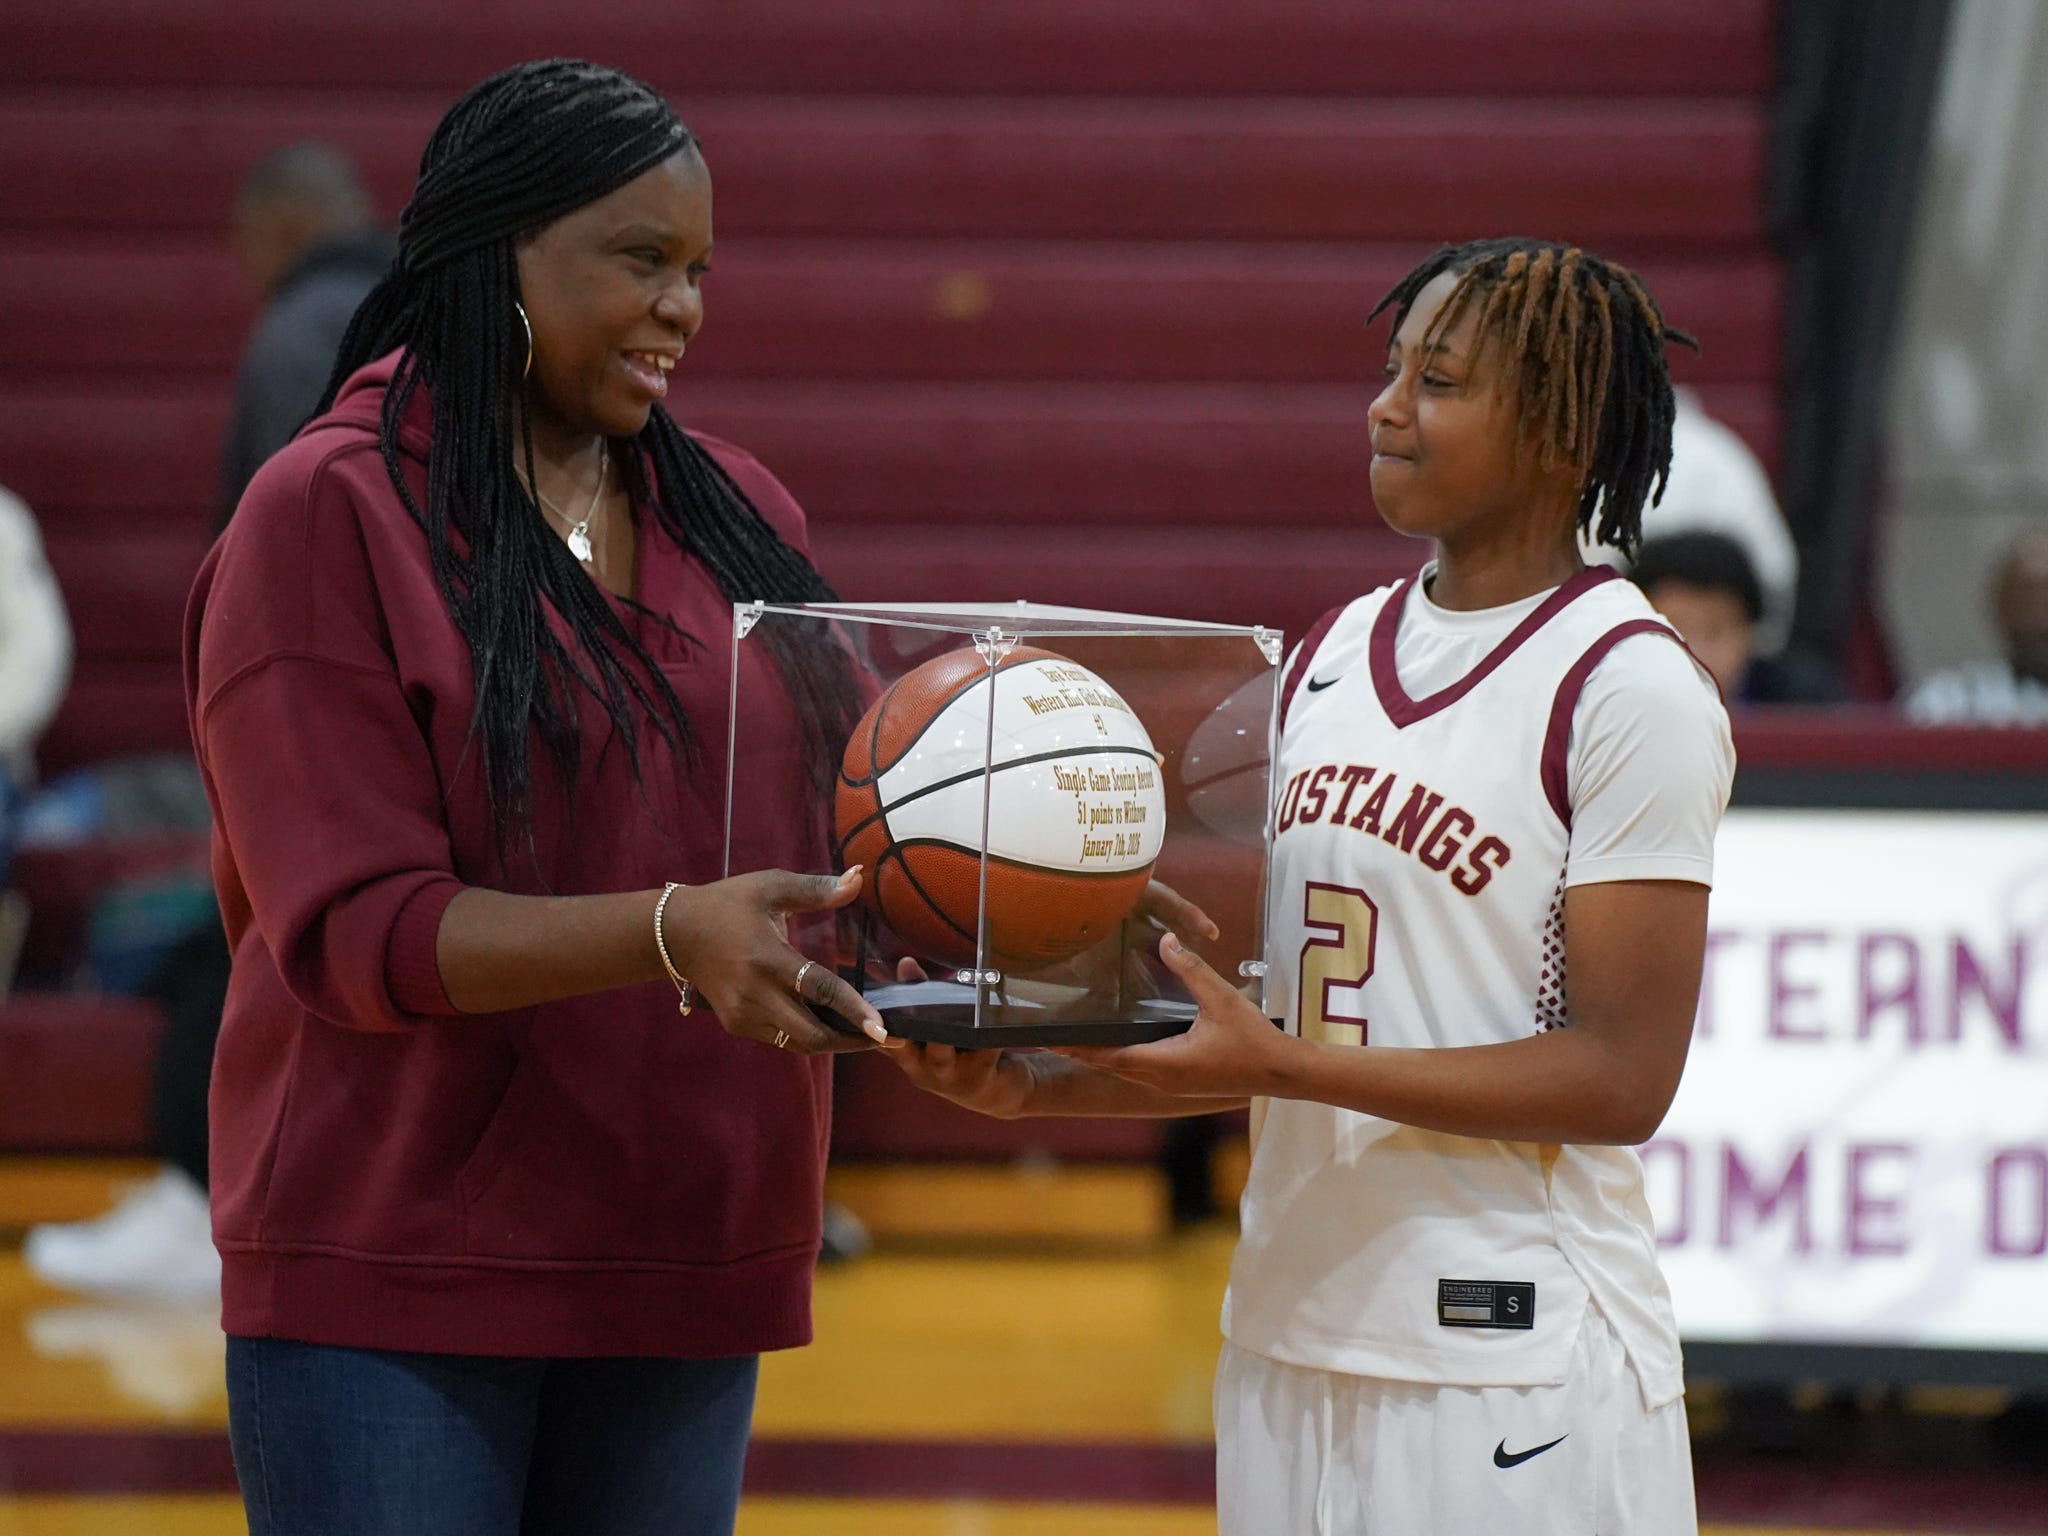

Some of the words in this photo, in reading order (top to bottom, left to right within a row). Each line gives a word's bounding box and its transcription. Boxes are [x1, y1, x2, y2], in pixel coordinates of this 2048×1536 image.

[1023, 693, 1065, 716] Western
[1053, 765, 1086, 798] Single
[1088, 767, 1111, 791] Game
[1111, 767, 1137, 797] Scoring
[1077, 801, 1087, 824] 51
[1090, 801, 1113, 831] points
[1115, 807, 1122, 824] vs
[1273, 765, 1511, 896] USTANGS
[1080, 834, 1113, 864] January
[1297, 881, 1378, 1046] 2
[1443, 1286, 1492, 1294] ENGINEERED
[1507, 1296, 1519, 1313] S
